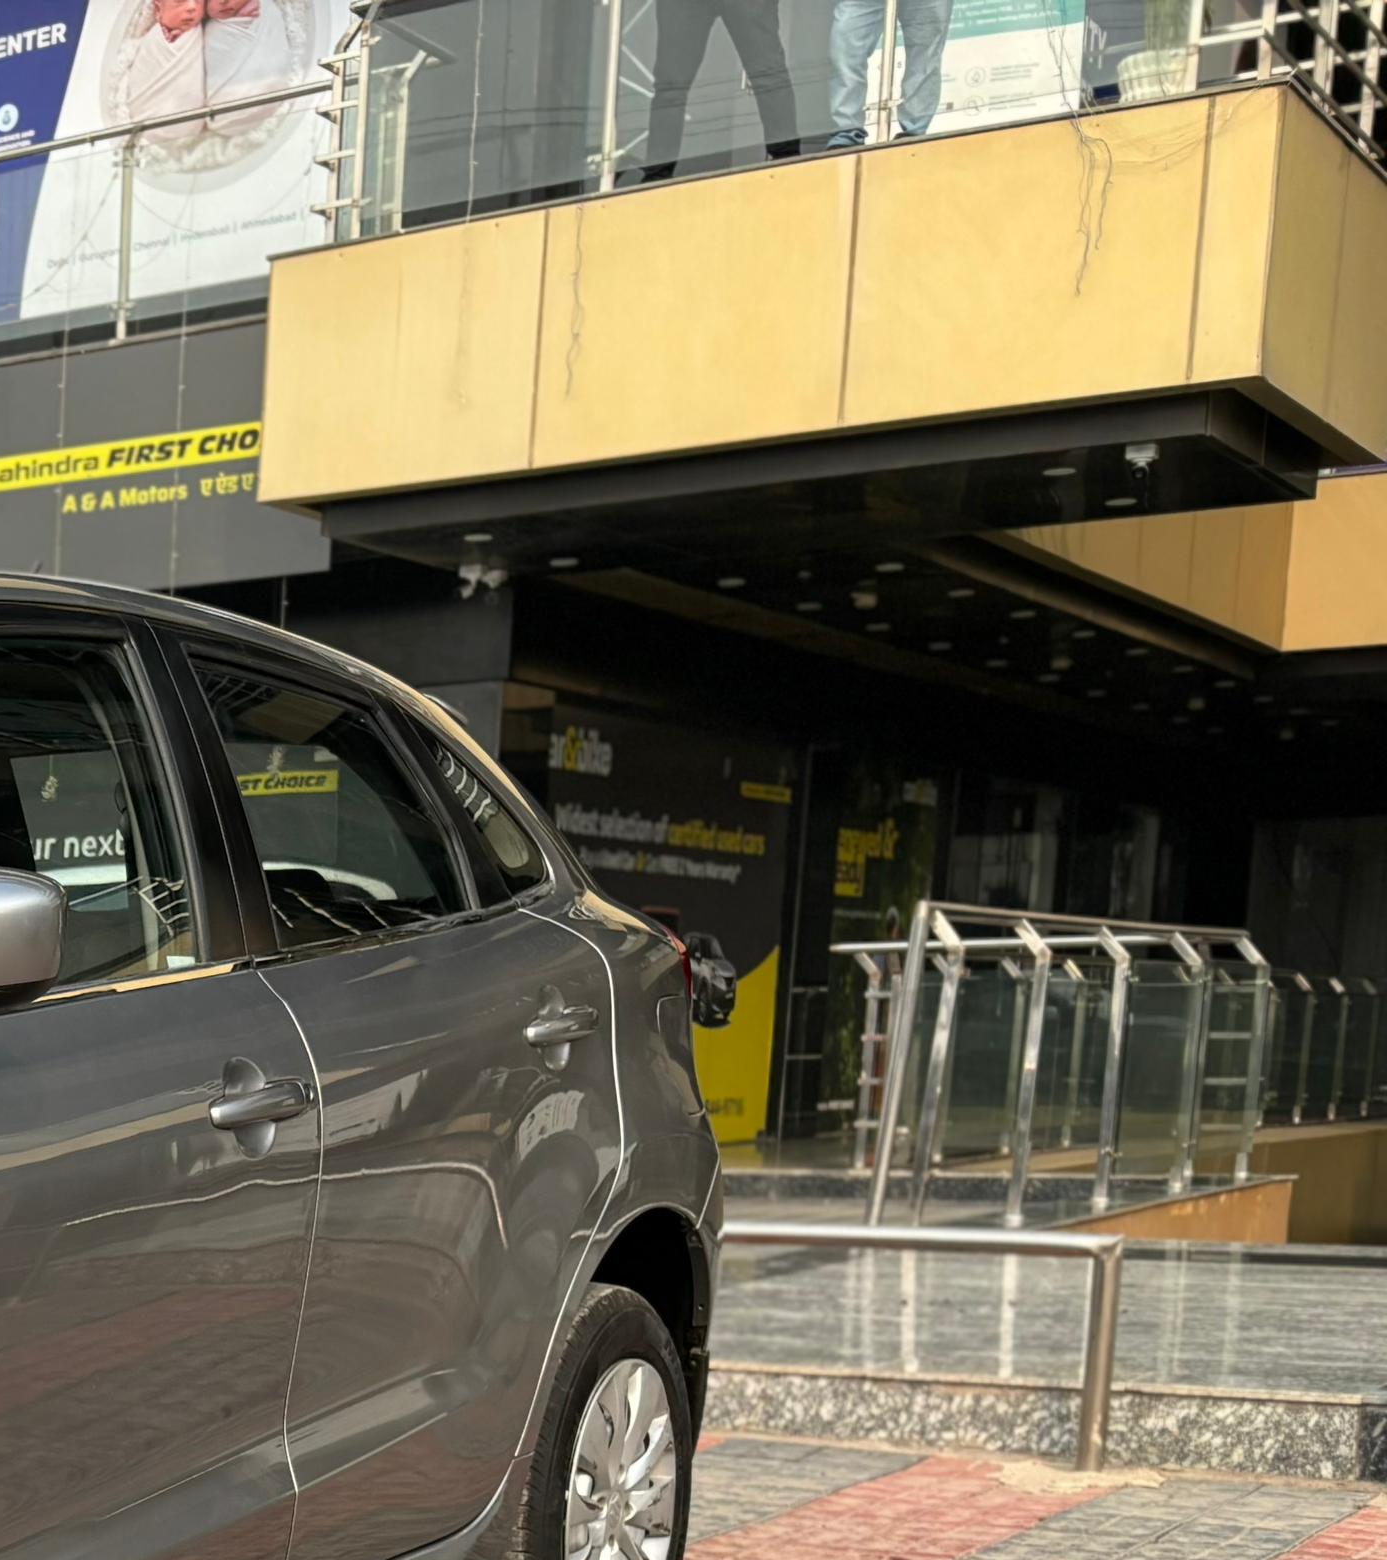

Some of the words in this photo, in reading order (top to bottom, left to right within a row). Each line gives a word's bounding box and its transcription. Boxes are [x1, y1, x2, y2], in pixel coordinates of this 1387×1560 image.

[106, 438, 194, 468] FIRST
[197, 428, 261, 456] CHO
[62, 495, 77, 514] A
[81, 493, 97, 512] &
[100, 490, 115, 509] A
[119, 482, 188, 508] Motors
[63, 828, 125, 858] next
